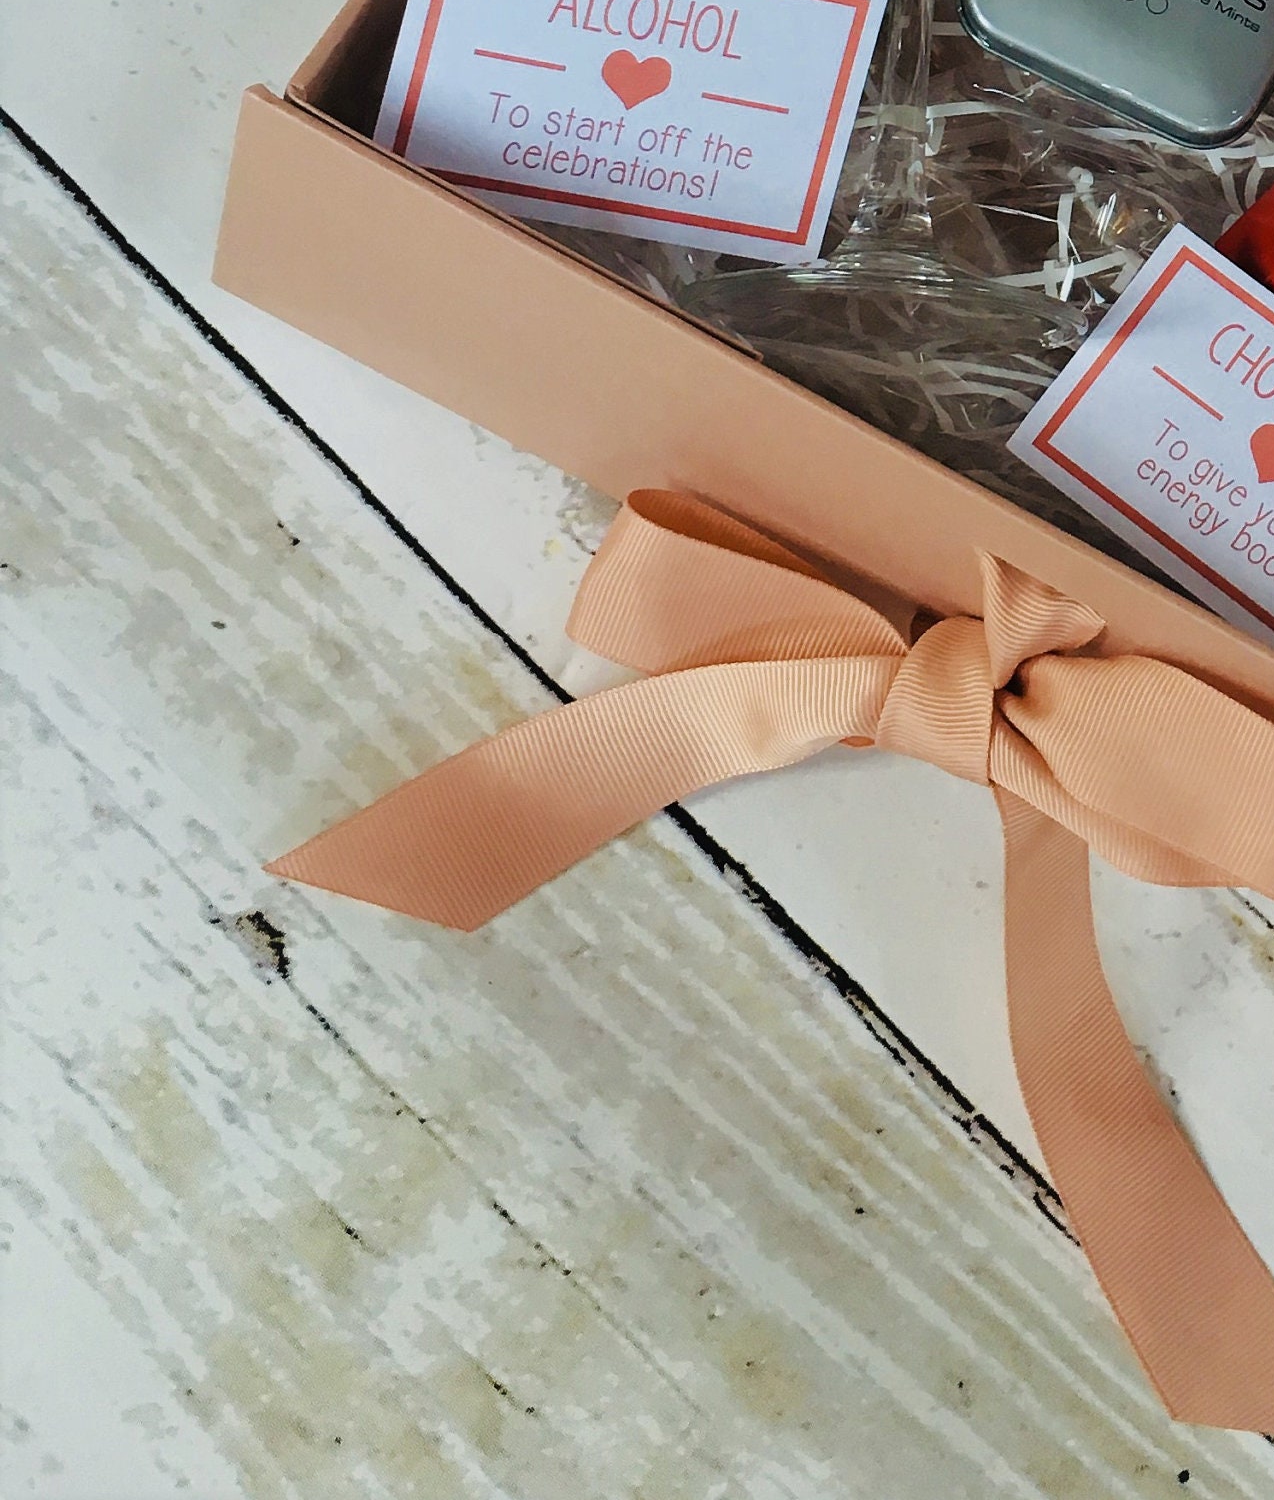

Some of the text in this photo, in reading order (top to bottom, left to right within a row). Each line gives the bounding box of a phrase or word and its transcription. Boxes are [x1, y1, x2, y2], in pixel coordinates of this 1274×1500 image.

[1214, 0, 1261, 33] Mints
[489, 92, 753, 171] To start off the
[502, 139, 721, 201] celebrations!
[1137, 459, 1229, 536] energy
[1155, 418, 1188, 460] To
[1188, 459, 1247, 507] give
